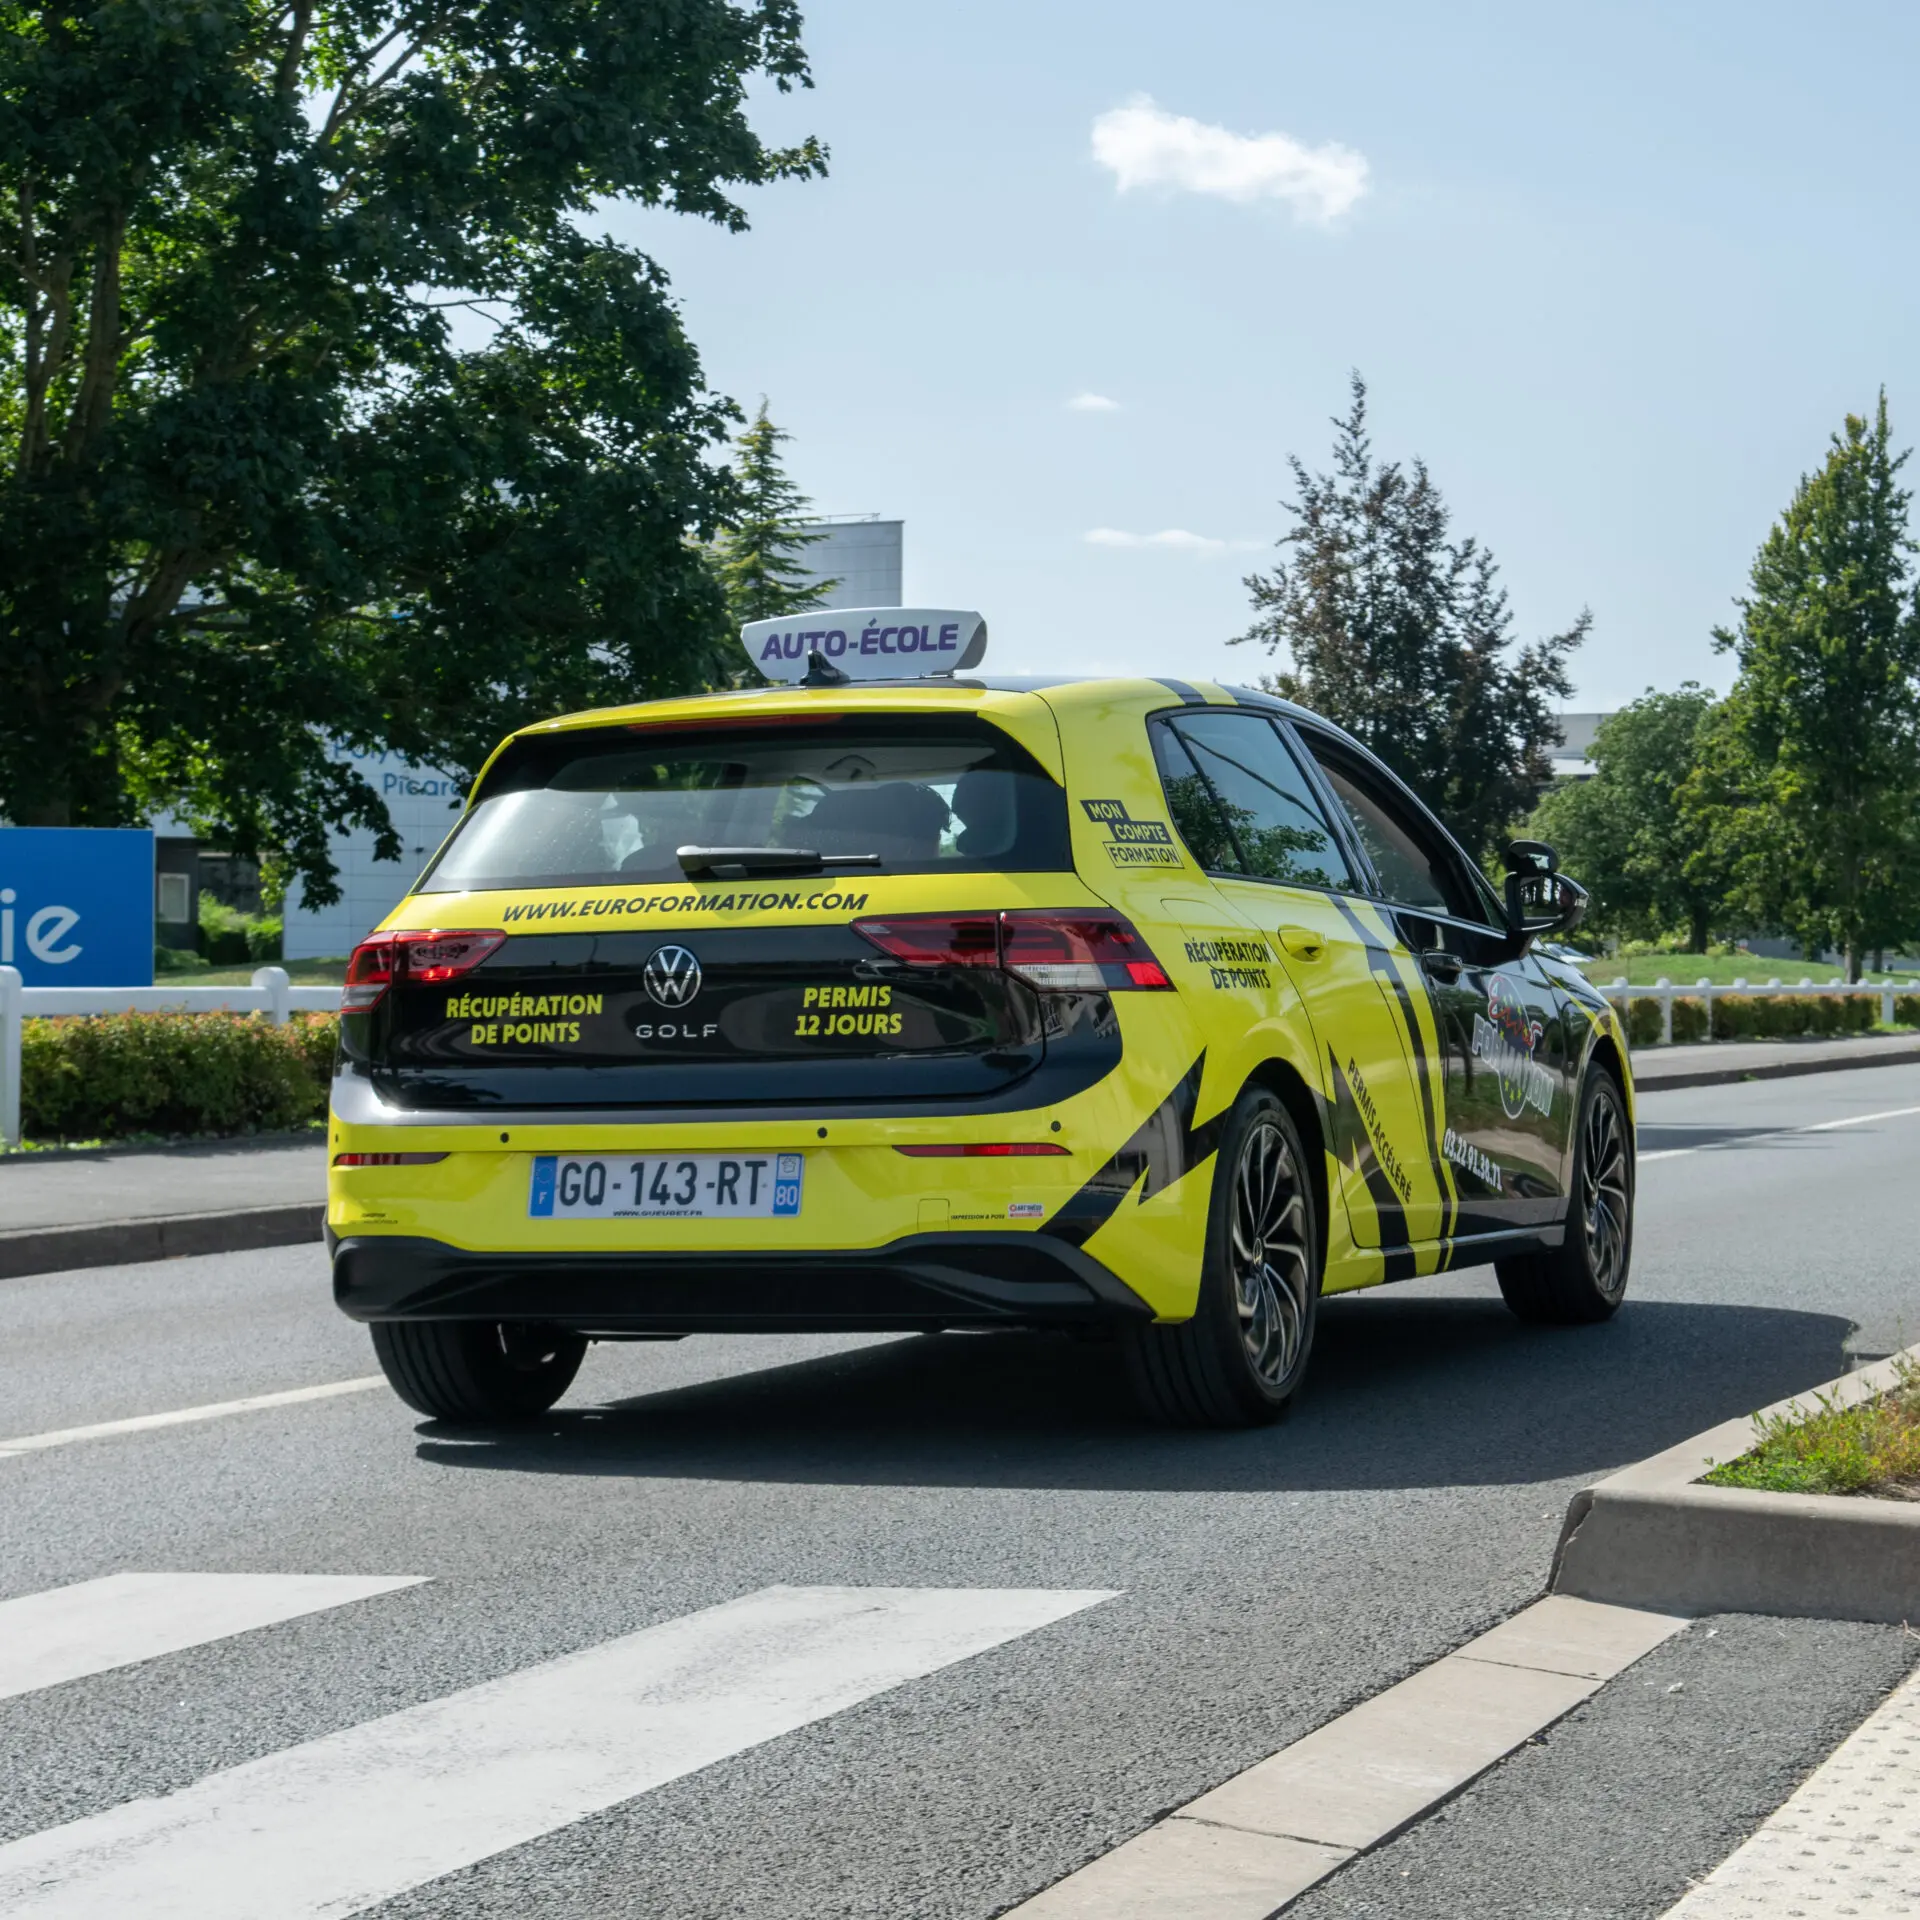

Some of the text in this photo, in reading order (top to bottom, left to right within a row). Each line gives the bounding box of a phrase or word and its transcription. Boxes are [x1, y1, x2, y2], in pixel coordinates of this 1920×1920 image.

[760, 617, 959, 661] AUTO-ÉCOLE
[1088, 803, 1124, 819] MON
[1114, 823, 1167, 841] COMPTE
[1109, 847, 1180, 865] FORMATION
[503, 893, 869, 922] WWW.EUROFORMATION.COM
[1184, 936, 1272, 963] RÉCUPÉRATION
[1210, 967, 1271, 990] DE POINTS
[446, 992, 603, 1018] RÉCUPÉRATION
[803, 985, 892, 1008] PERMIS
[471, 1022, 580, 1044] DE POINTS
[635, 1024, 718, 1039] GOLF
[795, 1013, 903, 1036] 12 JOURS
[1348, 1056, 1412, 1204] PERMIS ACCÉLÉRÉ
[559, 1161, 767, 1206] GQ-143-RT
[538, 1191, 547, 1205] F
[776, 1185, 798, 1206] 80
